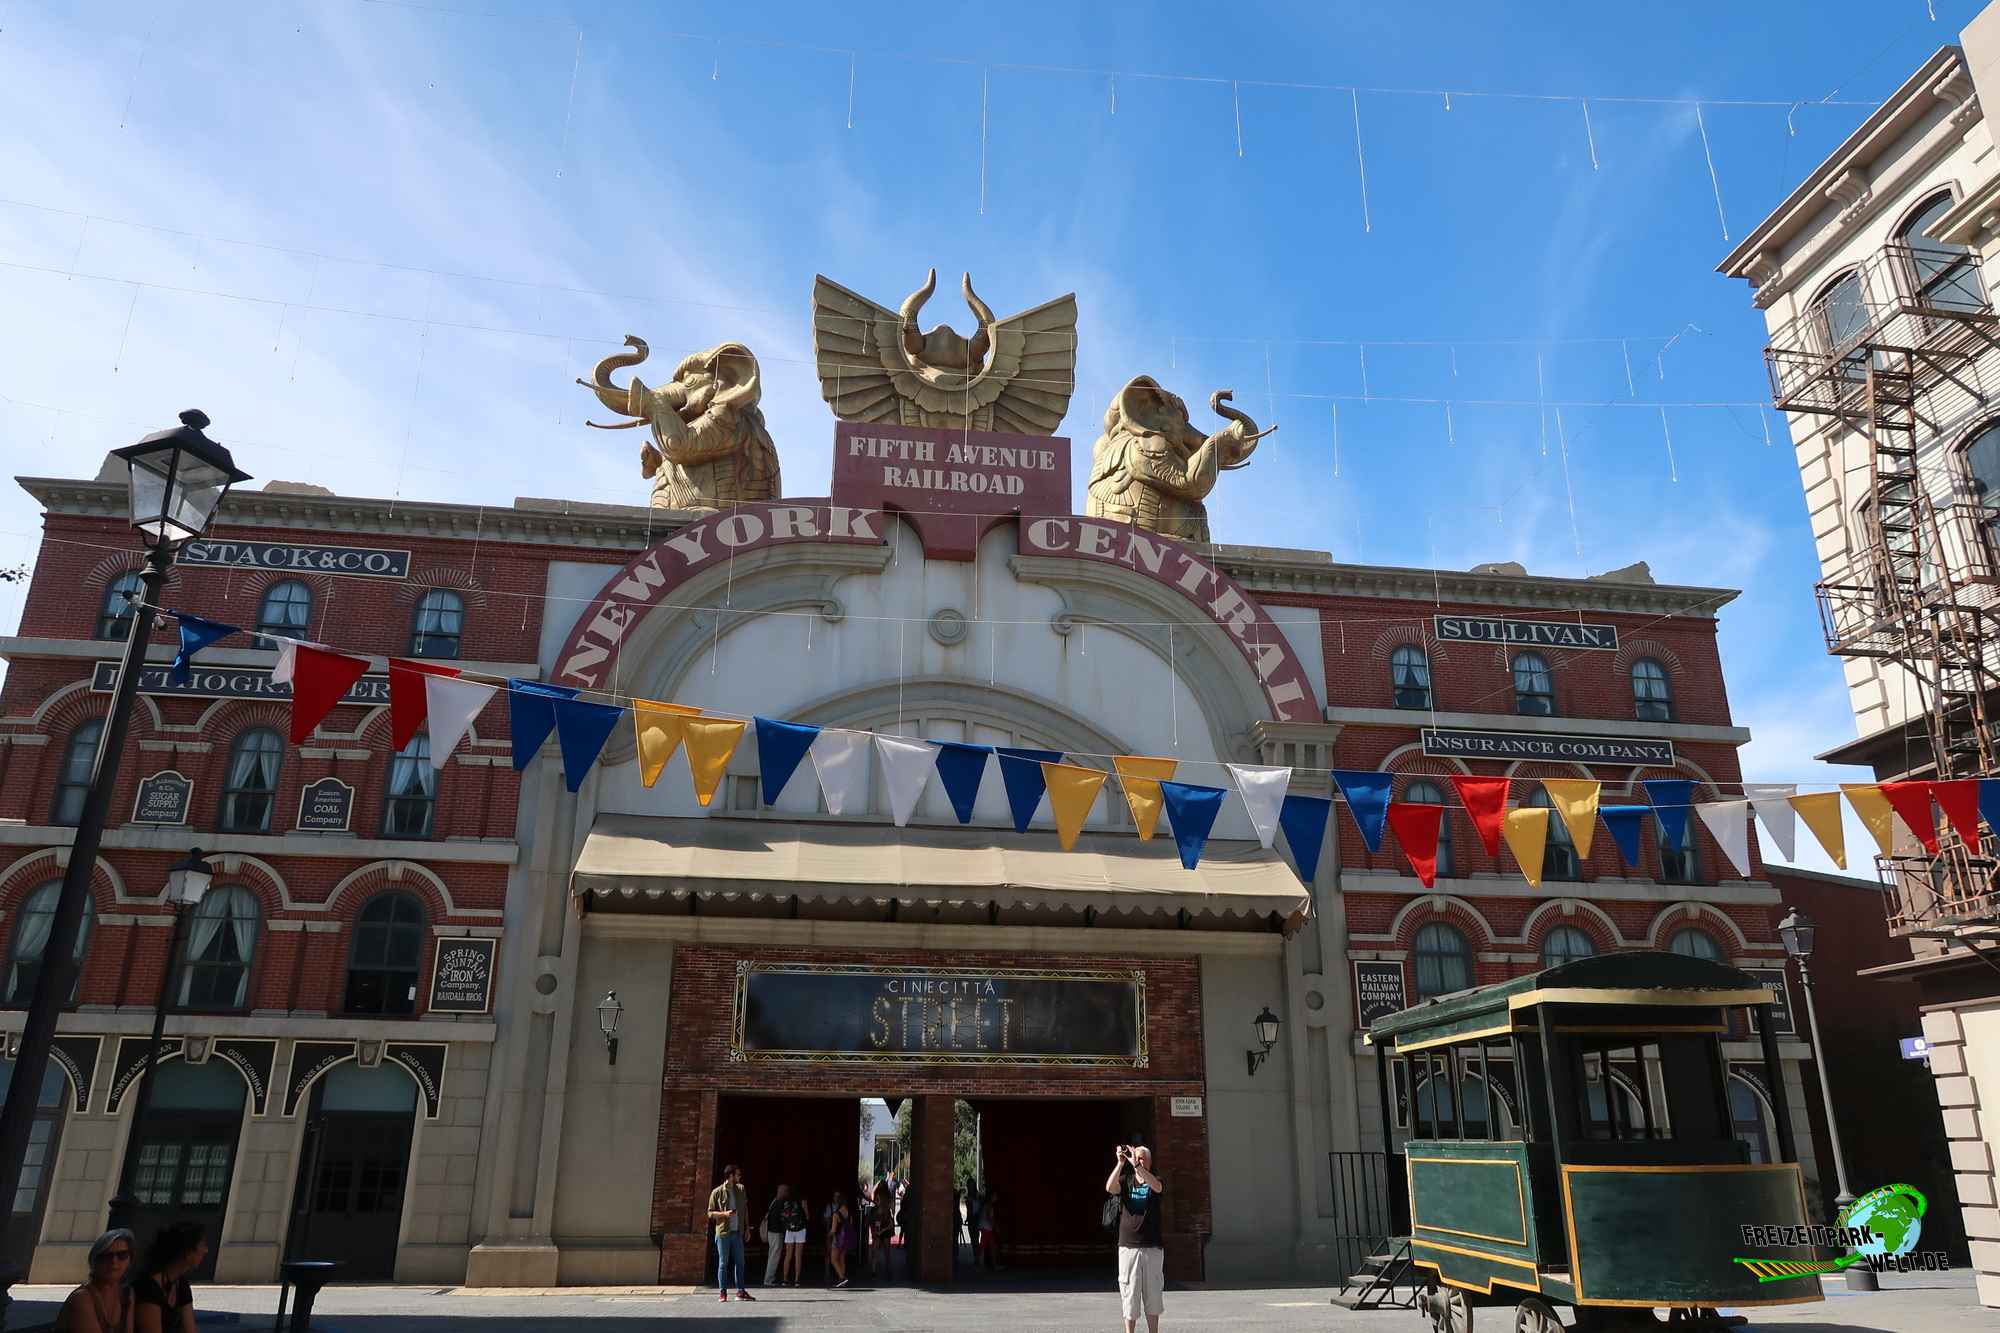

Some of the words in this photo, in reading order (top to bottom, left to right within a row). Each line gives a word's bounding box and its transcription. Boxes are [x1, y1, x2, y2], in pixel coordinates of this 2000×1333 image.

[849, 436, 936, 462] FIFTH
[945, 443, 1056, 471] AVENUE
[883, 466, 1025, 496] RAILROAD
[185, 542, 399, 573] STACK&CO.
[560, 551, 668, 688] NEW
[664, 507, 882, 566] YORK
[1027, 518, 1305, 721] CENTRAL
[1443, 619, 1612, 647] SULLIVAN.
[1426, 736, 1554, 754] INSURANCE
[1559, 742, 1671, 759] COMPANY.
[313, 804, 340, 814] COAL
[443, 948, 486, 963] SPRING
[439, 957, 487, 980] MOUNTAIN
[450, 969, 474, 982] IRON
[1360, 974, 1400, 983] EASTERN
[1361, 991, 1402, 1001] COMPANY
[1362, 983, 1399, 992] RAILWAY
[870, 996, 1014, 1049] STREET
